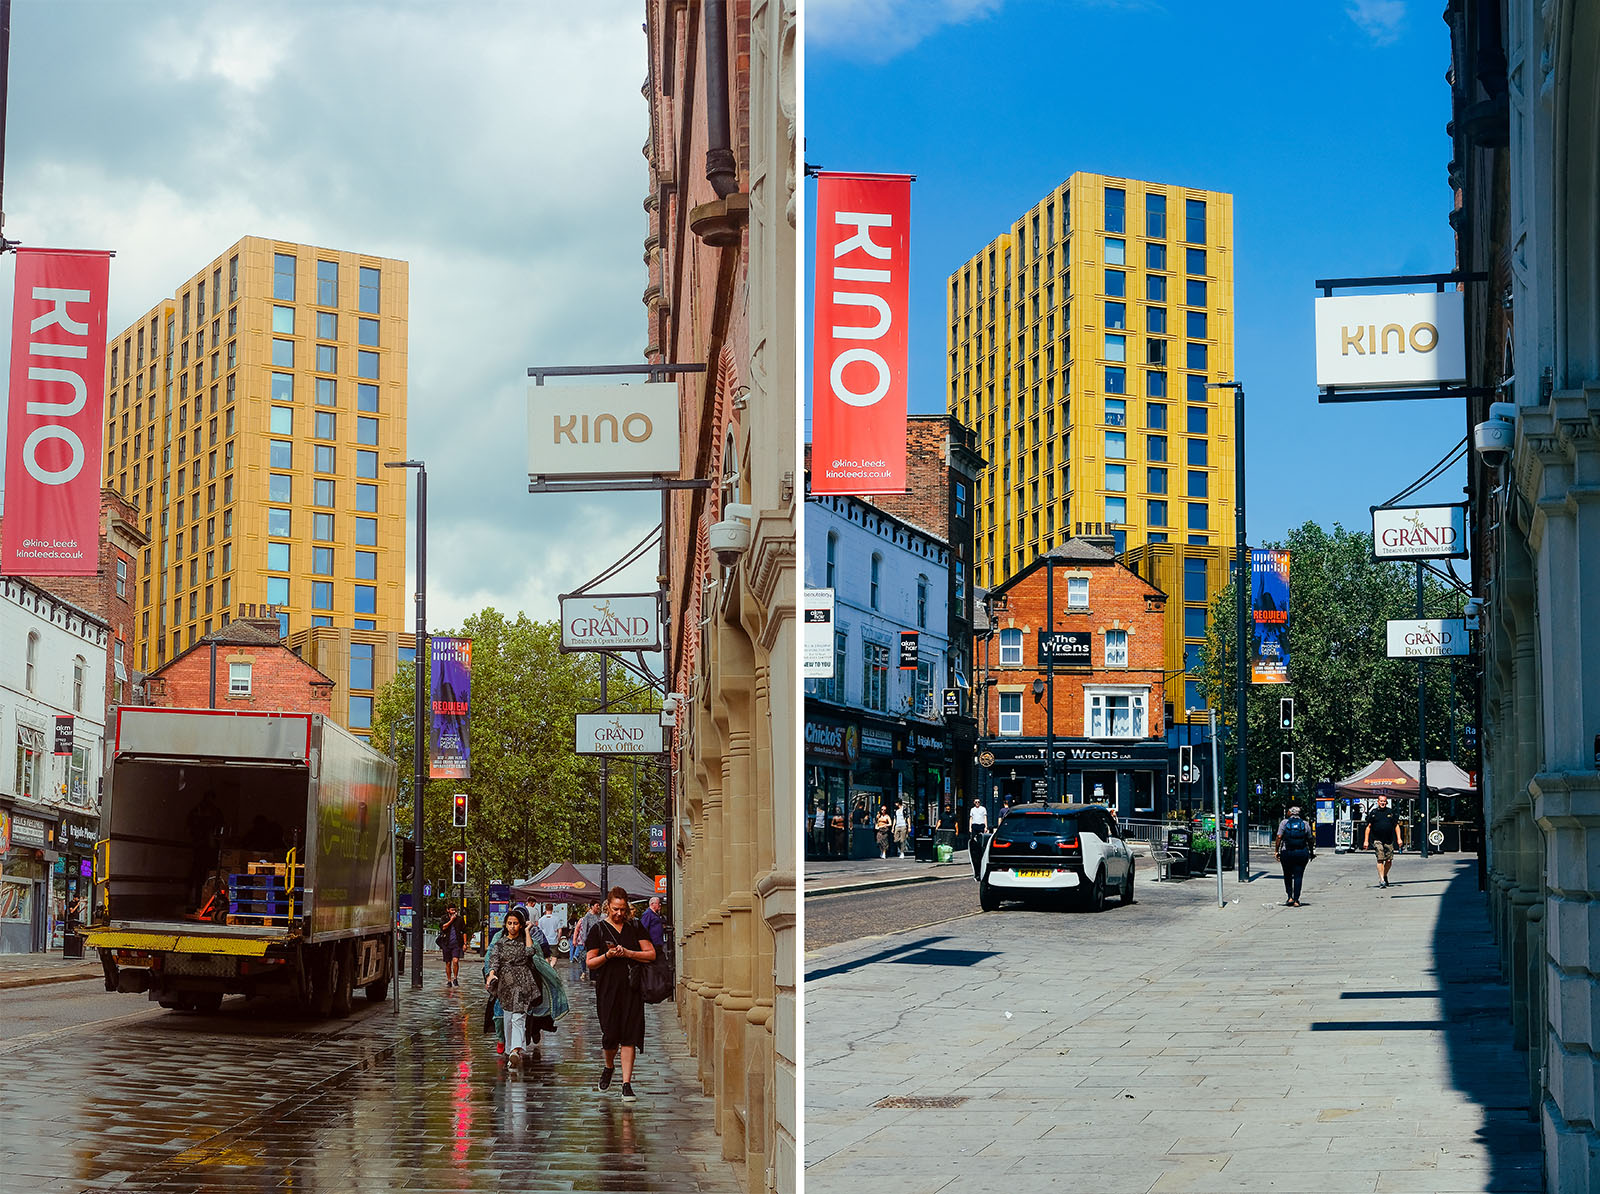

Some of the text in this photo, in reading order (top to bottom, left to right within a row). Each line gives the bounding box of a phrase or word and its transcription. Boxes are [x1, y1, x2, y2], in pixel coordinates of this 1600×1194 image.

[831, 459, 886, 468] @kino_leeds
[825, 469, 892, 478] kinoleeds.co.uk
[1382, 526, 1457, 547] GRAND
[22, 539, 78, 548] @kino_leeds
[16, 549, 84, 558] kinoleeds.co.uk
[1253, 553, 1287, 563] opera
[1253, 562, 1287, 572] north
[1253, 610, 1287, 620] REQUIEM
[570, 617, 649, 637] GRAND
[599, 637, 615, 645] Opera
[1054, 634, 1077, 643] The
[1404, 631, 1452, 645] GRAND
[433, 641, 469, 652] opera
[1041, 642, 1090, 652] Wrens
[1405, 645, 1452, 656] Box Office
[433, 651, 469, 661] north
[432, 701, 468, 711] REQUIEM
[594, 728, 644, 741] GRAND
[805, 722, 842, 748] Chicko's
[595, 742, 645, 752] Box Office
[1071, 749, 1118, 759] Wrens
